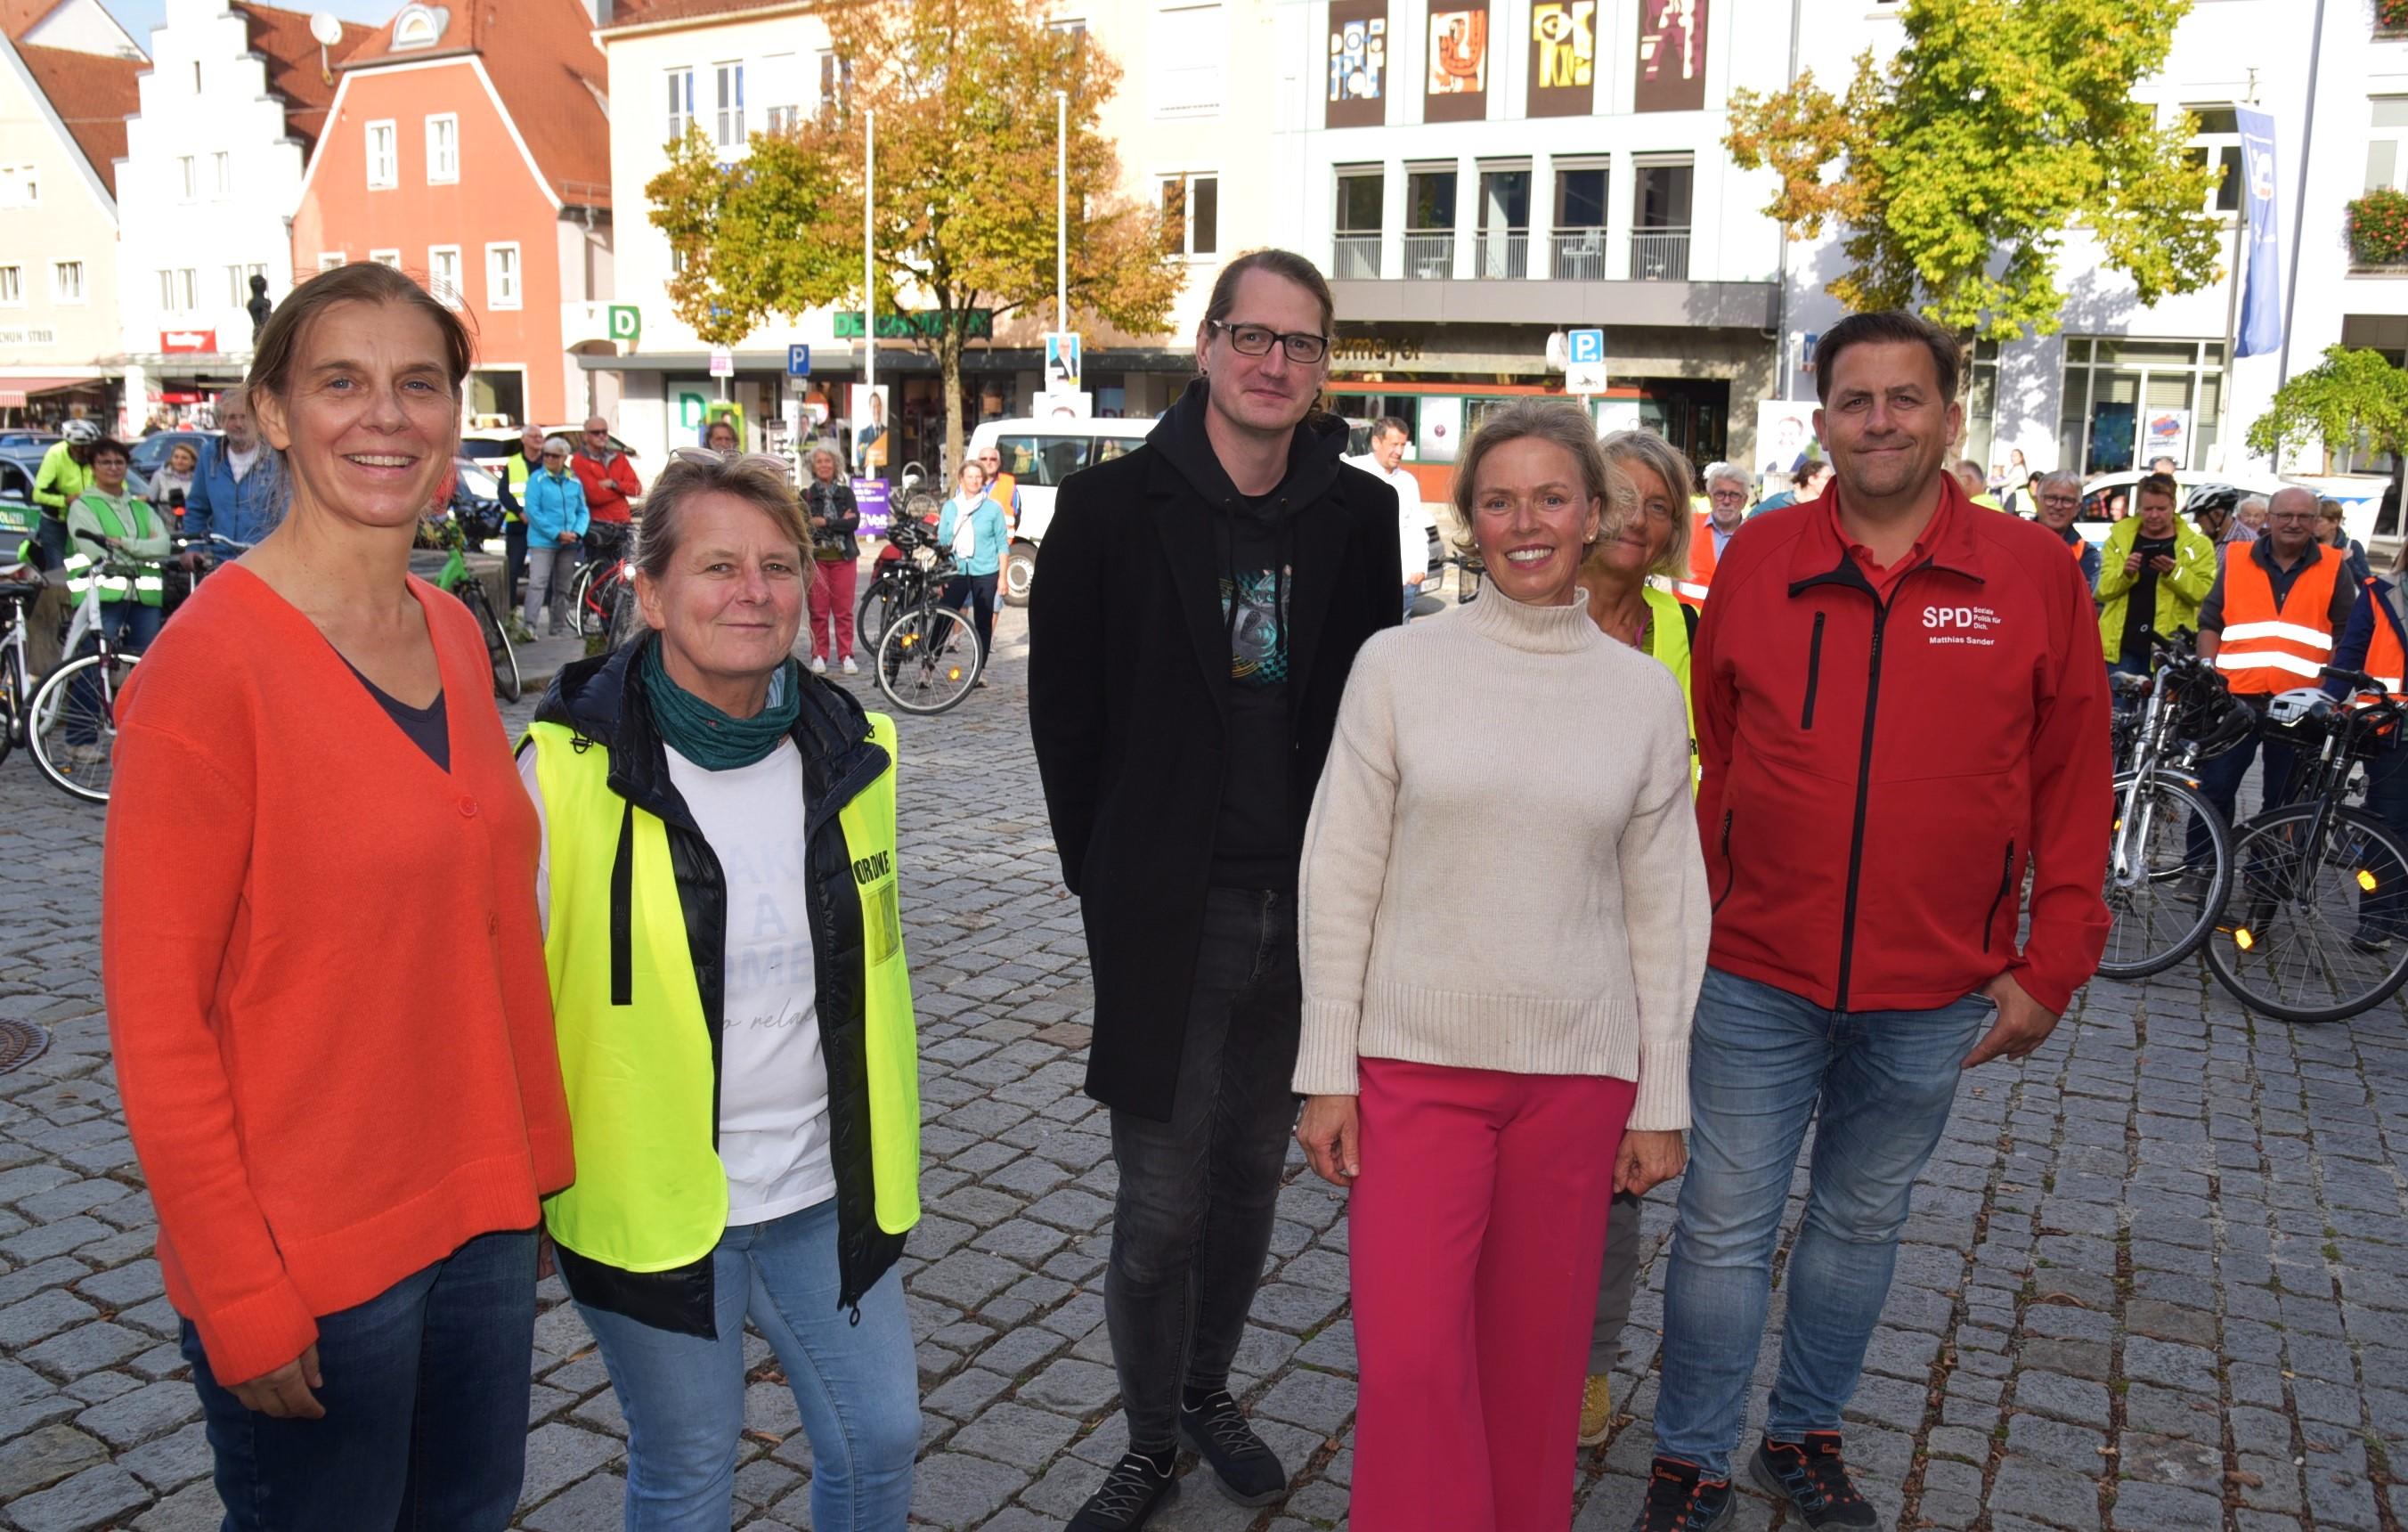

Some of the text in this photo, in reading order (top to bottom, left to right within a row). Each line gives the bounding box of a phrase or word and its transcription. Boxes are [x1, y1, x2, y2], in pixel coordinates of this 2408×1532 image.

[614, 309, 636, 336] D
[792, 346, 805, 372] P
[1576, 334, 1596, 362] P
[1922, 606, 1973, 628] SPD
[1973, 615, 2001, 624] Politik für
[1973, 623, 1989, 631] Dich.
[1929, 636, 1995, 646] Matthias Sander
